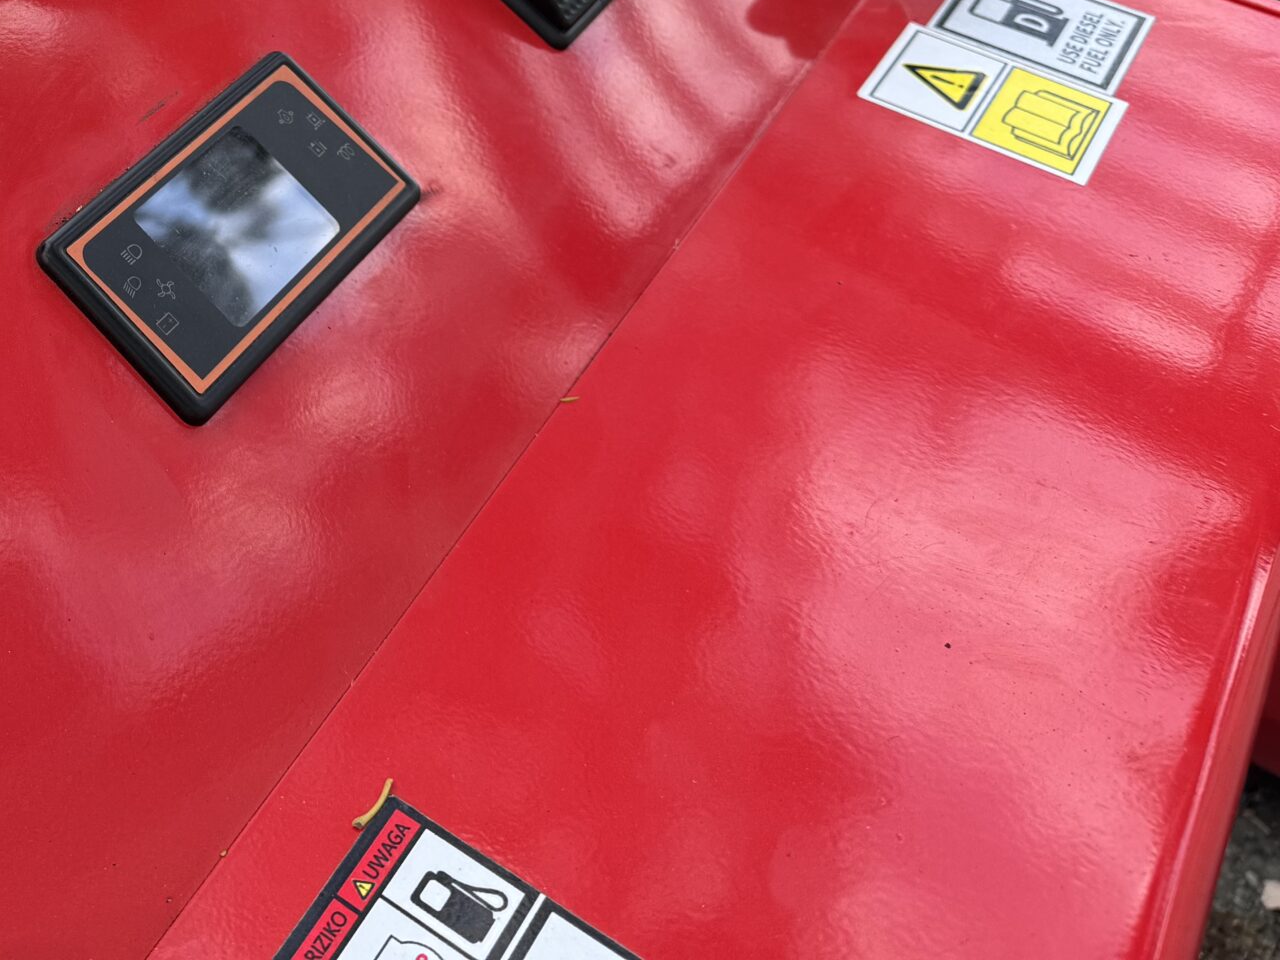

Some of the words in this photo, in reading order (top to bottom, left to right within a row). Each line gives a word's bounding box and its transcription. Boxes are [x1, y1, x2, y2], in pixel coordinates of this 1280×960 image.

[1014, 13, 1050, 33] D
[1056, 42, 1084, 64] USE
[1070, 12, 1104, 44] DIESEL
[1079, 48, 1108, 74] FUEL
[1094, 19, 1125, 47] ONLY.
[362, 823, 411, 880] UWAGA
[304, 911, 347, 960] RIZIKO
